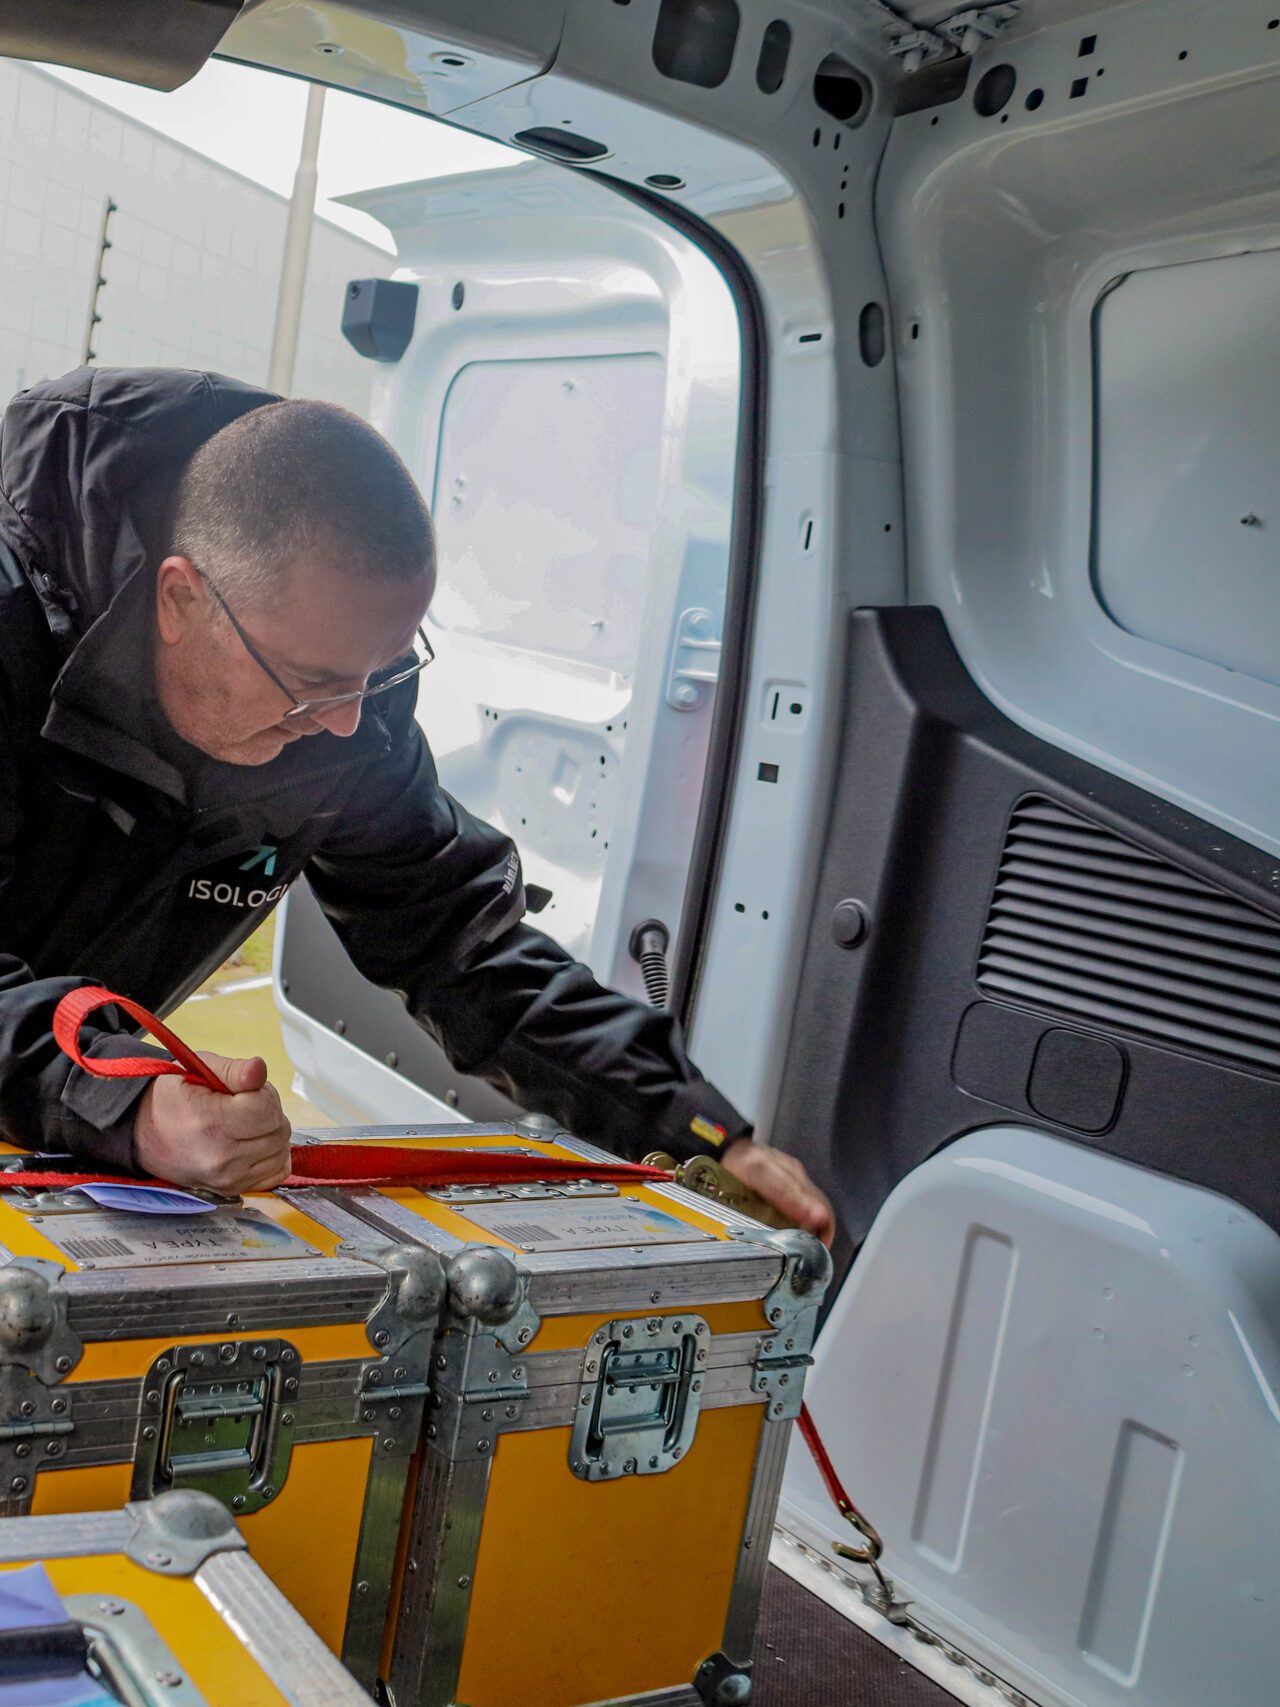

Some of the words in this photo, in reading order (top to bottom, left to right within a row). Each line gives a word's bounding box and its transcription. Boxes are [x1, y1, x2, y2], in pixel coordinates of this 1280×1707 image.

[578, 1224, 630, 1234] TYPE
[141, 1240, 158, 1249] A
[162, 1238, 222, 1249] TYPE
